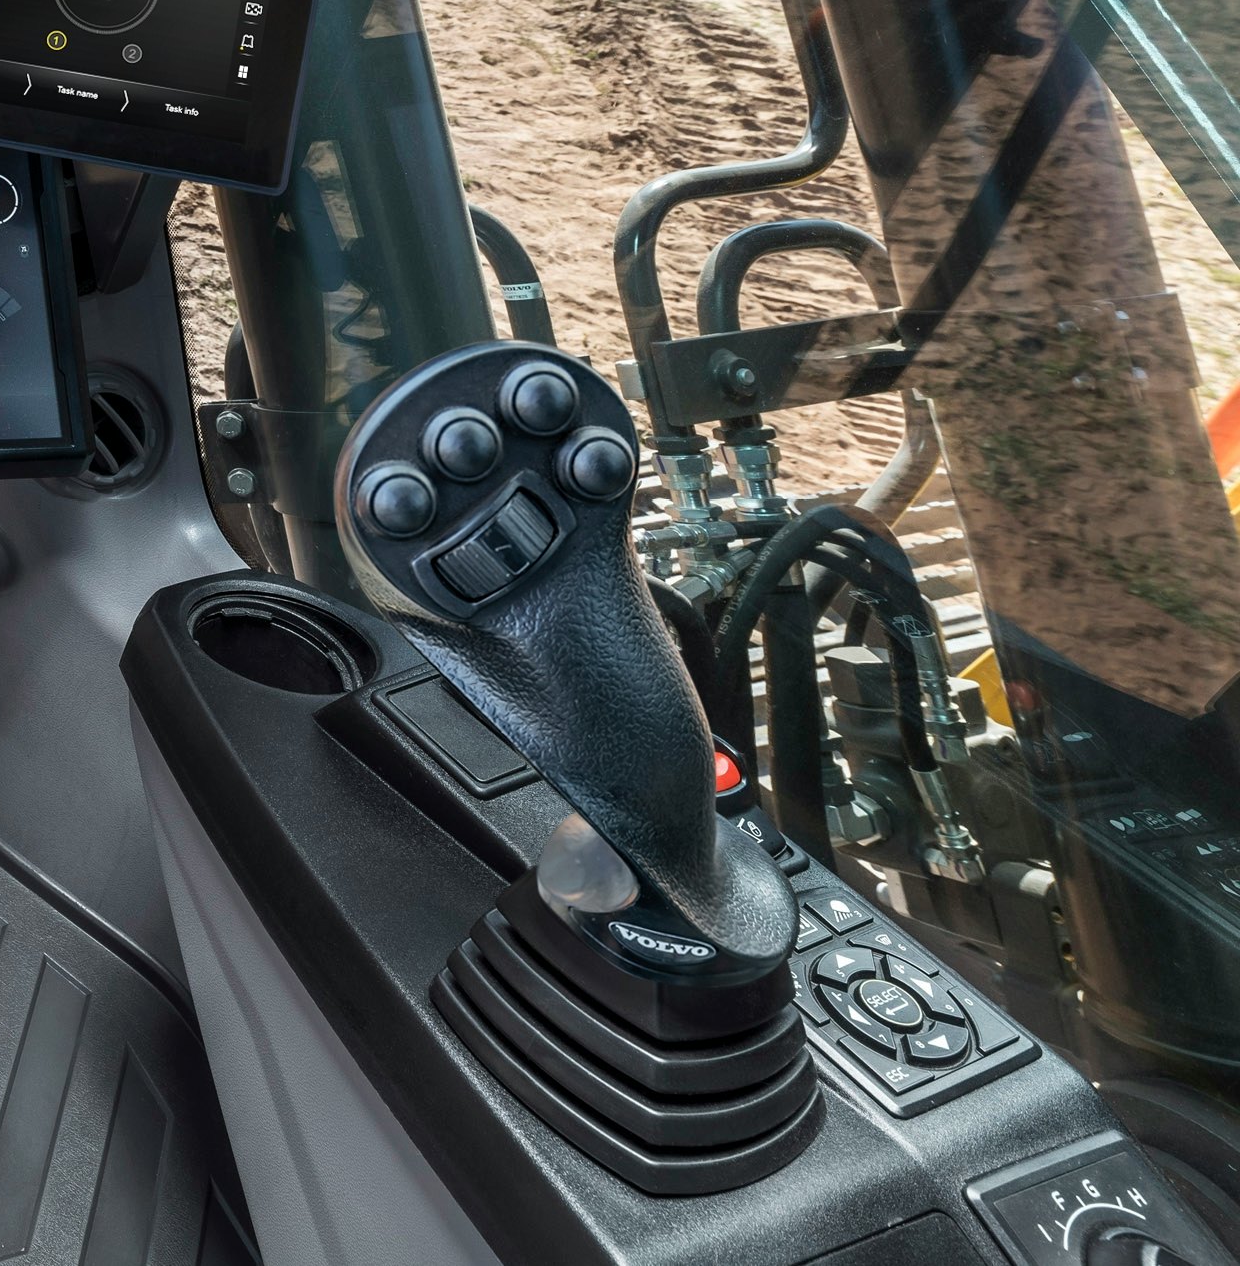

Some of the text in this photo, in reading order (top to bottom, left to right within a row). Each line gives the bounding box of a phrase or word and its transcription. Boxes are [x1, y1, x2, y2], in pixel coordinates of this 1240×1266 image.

[57, 85, 99, 100] Task name
[165, 103, 199, 116] Task info
[718, 614, 732, 635] ISO
[615, 924, 709, 956] VOLVO
[867, 987, 902, 1008] SELECT
[886, 1067, 909, 1082] ESC
[1082, 1178, 1101, 1198] G
[1126, 1187, 1148, 1208] H
[1051, 1190, 1066, 1211] F
